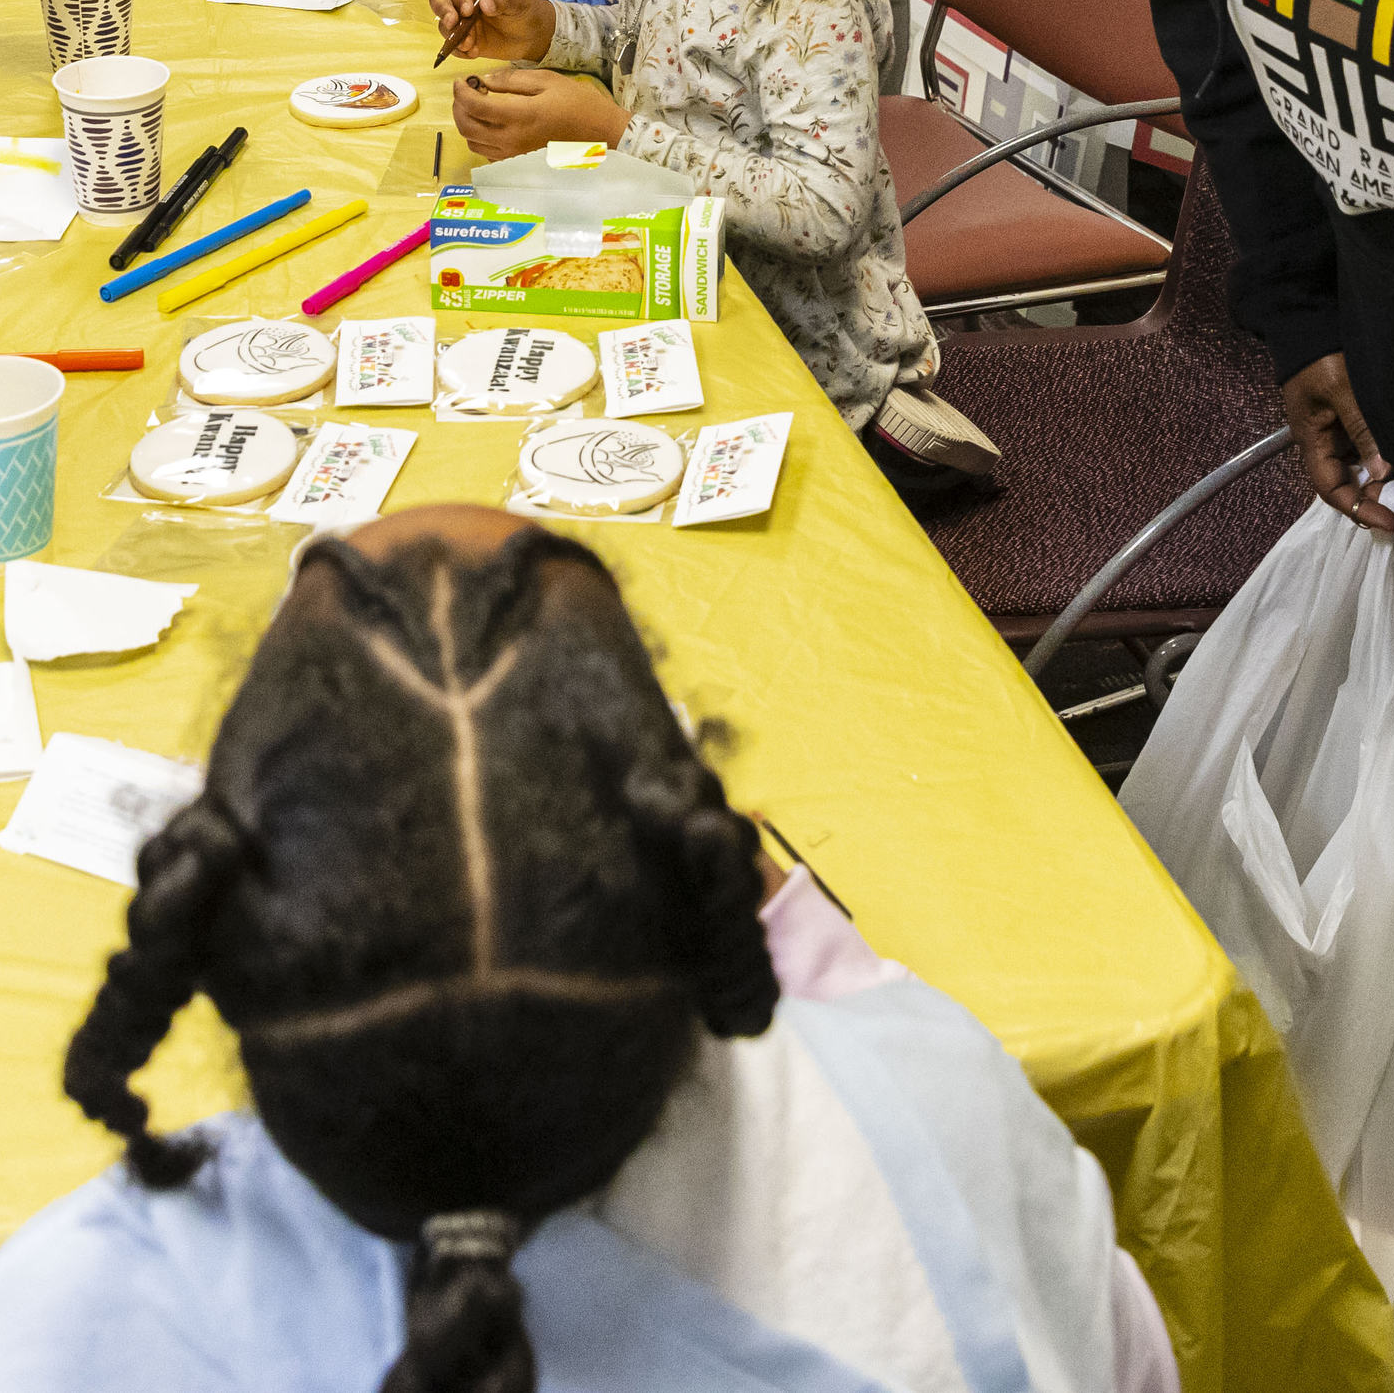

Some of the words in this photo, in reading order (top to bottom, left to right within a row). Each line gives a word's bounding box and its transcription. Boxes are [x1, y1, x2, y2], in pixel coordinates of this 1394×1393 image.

[1269, 86, 1341, 151] GRAND
[1276, 111, 1341, 177] AFRICAN
[434, 224, 510, 240] surefresh
[440, 209, 465, 218] 45
[700, 197, 715, 229] SANDWICH
[473, 289, 527, 302] ZIPPER
[654, 244, 673, 307] STORAGE
[695, 238, 709, 317] SANDWICH
[358, 335, 377, 391] KWANZAA
[488, 328, 531, 393] Kwanzaa!
[519, 339, 555, 385] Happy
[621, 340, 644, 398] KWANZAA
[215, 424, 258, 474] Happy
[302, 442, 352, 505] KWANZAA
[697, 439, 730, 504] KWANZAA
